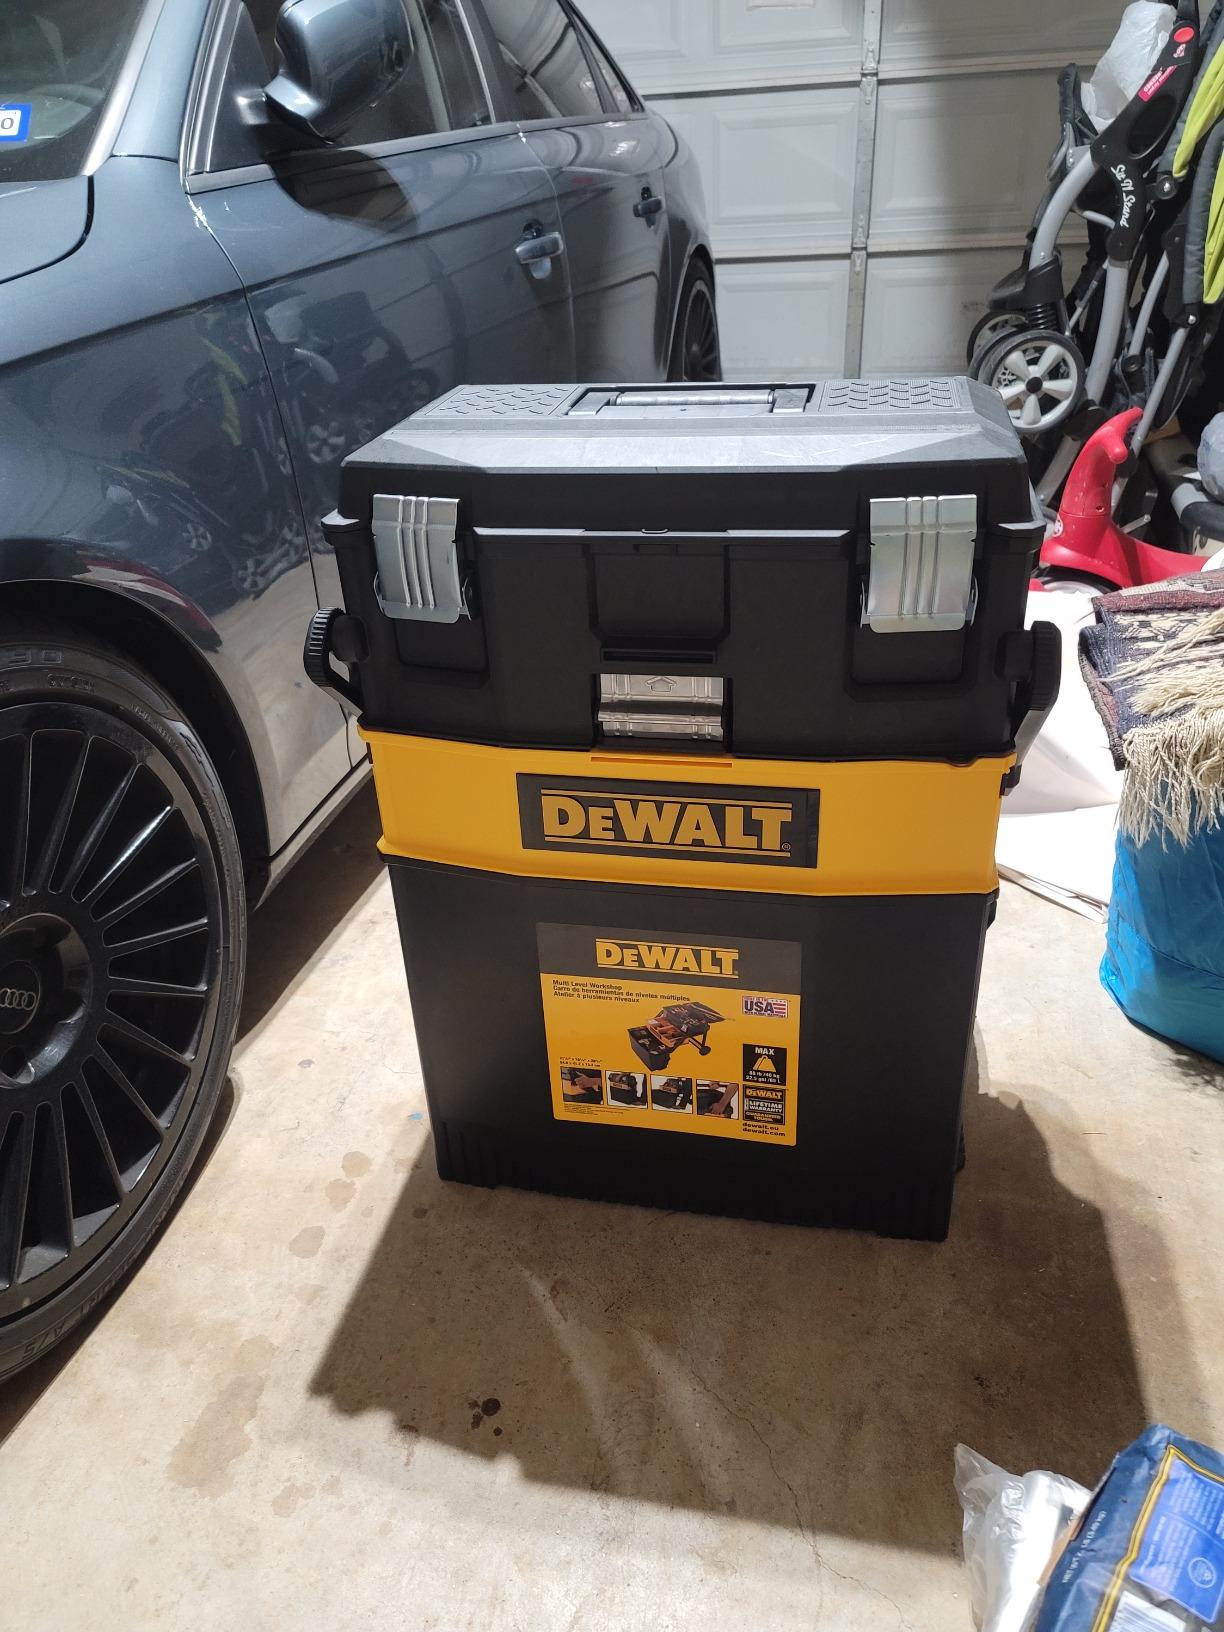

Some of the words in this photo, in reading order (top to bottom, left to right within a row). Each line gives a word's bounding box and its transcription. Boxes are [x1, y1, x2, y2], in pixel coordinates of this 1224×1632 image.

[1120, 192, 1136, 228] Stand
[590, 983, 622, 991] Workshop
[582, 988, 624, 996] herramientas
[582, 993, 612, 1001] plusieurs
[745, 1000, 774, 1013] USA
[755, 1047, 774, 1055] MAX
[750, 1101, 782, 1109] LIFETIME
